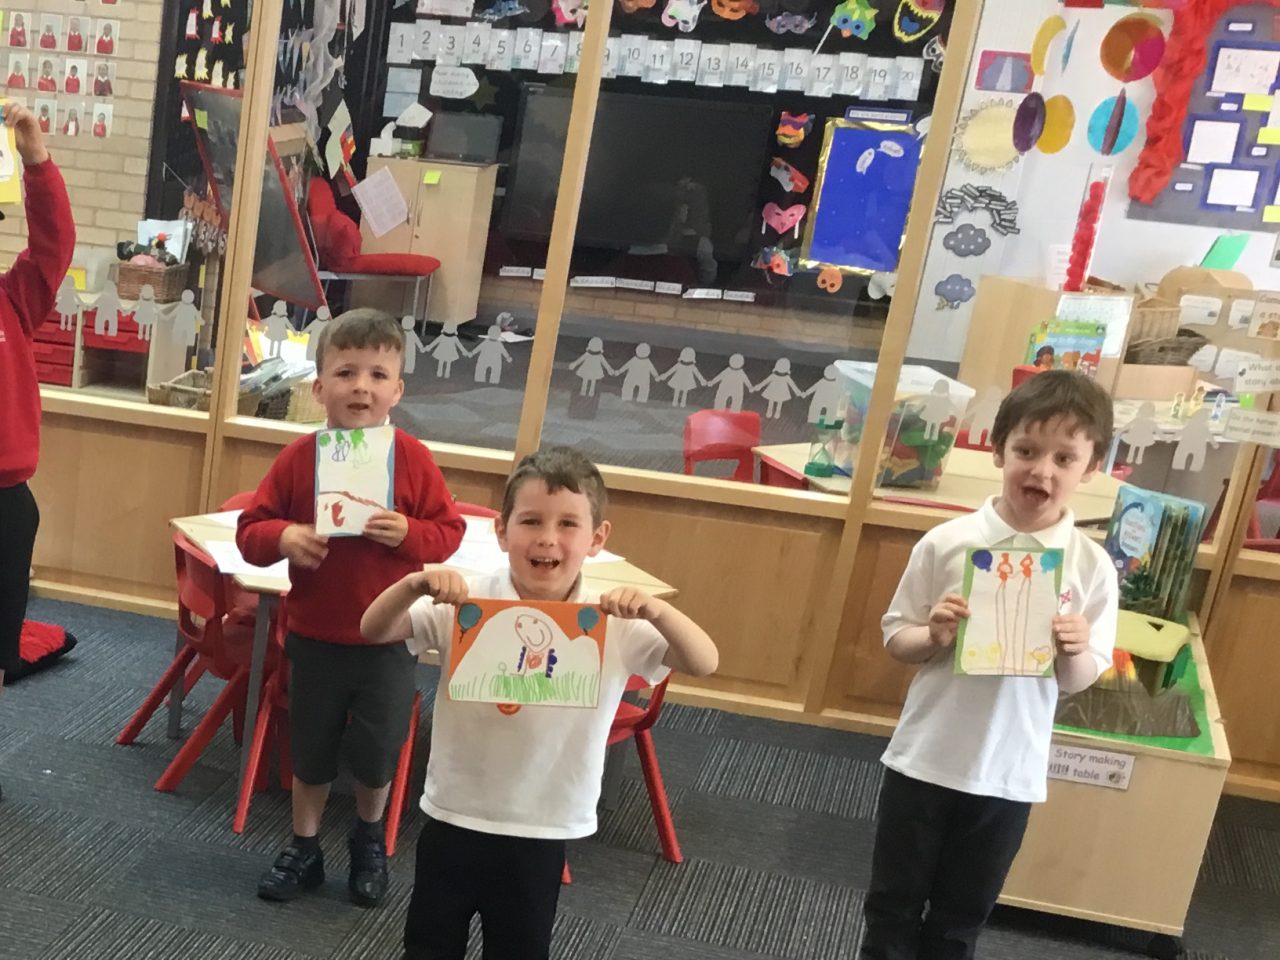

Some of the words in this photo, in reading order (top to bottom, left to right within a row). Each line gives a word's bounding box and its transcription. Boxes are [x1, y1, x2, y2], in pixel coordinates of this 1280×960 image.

[399, 34, 404, 47] 1
[422, 30, 431, 45] 2
[446, 36, 455, 50] 3
[472, 34, 481, 47] 4
[497, 40, 506, 54] 5
[523, 40, 532, 54] 6
[627, 47, 640, 60] 10
[652, 54, 664, 66] 11
[680, 52, 693, 66] 12
[706, 57, 721, 71] 13
[735, 56, 749, 70] 14
[761, 62, 775, 76] 15
[789, 62, 803, 76] 16
[816, 67, 831, 80] 17
[843, 66, 859, 80] 18
[872, 69, 887, 82] 19
[902, 71, 914, 81] 20
[1055, 748, 1086, 763] Story
[1089, 755, 1126, 770] making
[1073, 768, 1100, 781] table
